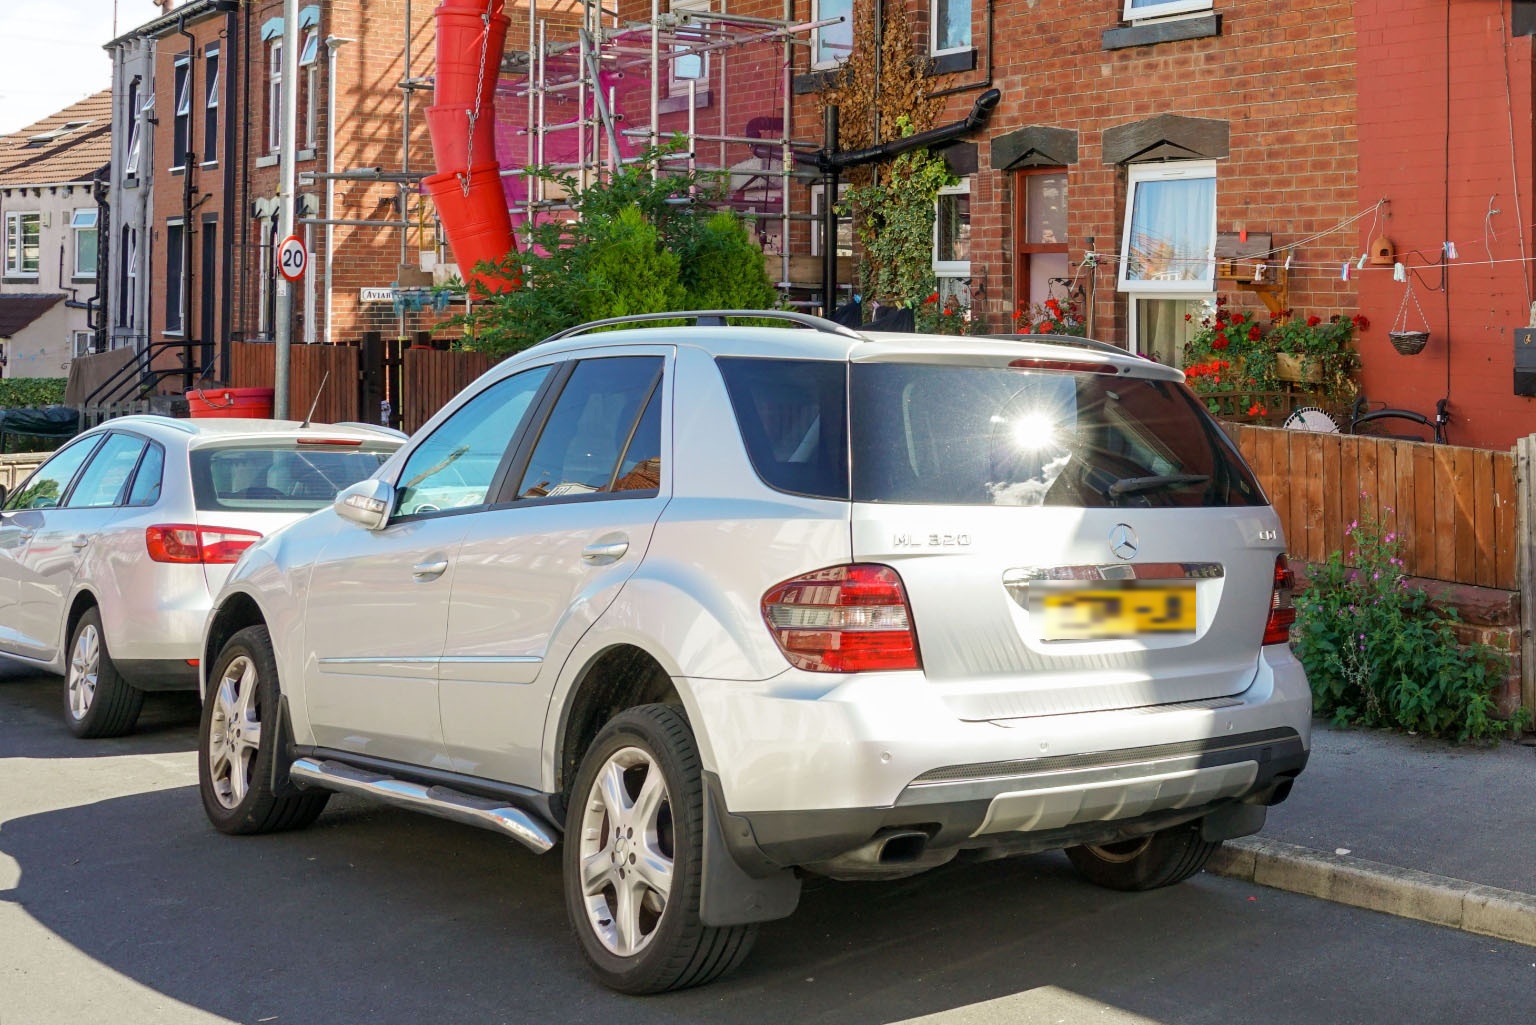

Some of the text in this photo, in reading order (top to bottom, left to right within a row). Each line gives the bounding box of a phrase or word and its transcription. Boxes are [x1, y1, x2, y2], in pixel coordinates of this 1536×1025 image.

[283, 249, 303, 268] 20
[366, 290, 392, 299] AVIAR
[894, 534, 972, 547] ML 320
